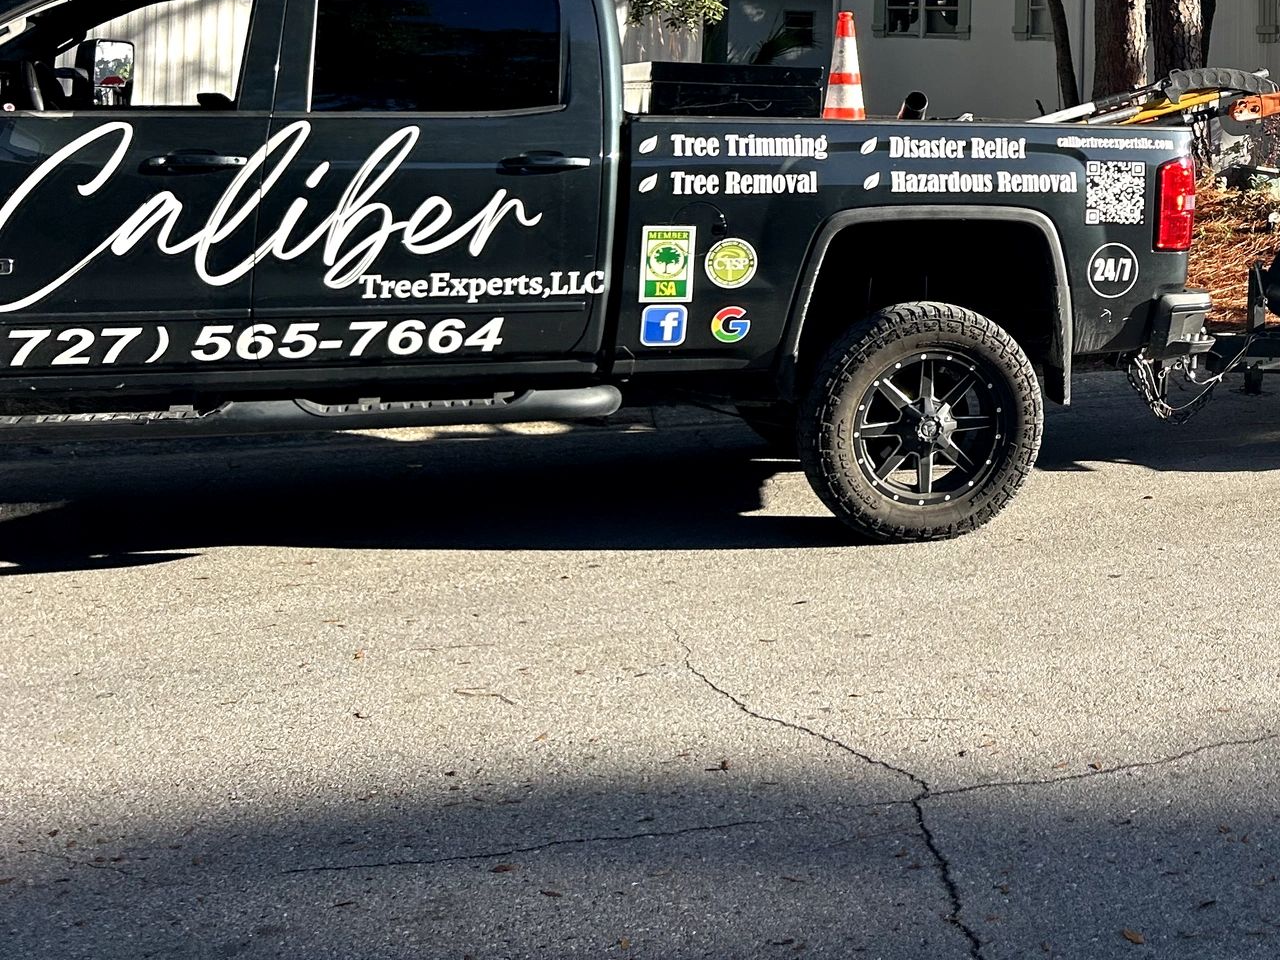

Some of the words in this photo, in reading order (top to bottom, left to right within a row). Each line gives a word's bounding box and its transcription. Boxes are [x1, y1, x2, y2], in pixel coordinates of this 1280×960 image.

[671, 133, 720, 157] Tree
[725, 133, 829, 160] Trimming
[889, 136, 967, 159] Disaster
[970, 137, 1027, 159] Relief
[671, 171, 720, 195] Tree
[725, 171, 818, 195] Removal
[891, 170, 993, 193] Hazardous
[997, 171, 1078, 193] Removal
[0, 120, 543, 313] Caliber
[648, 231, 689, 239] MEMBER
[1094, 257, 1133, 284] 24/7
[359, 270, 605, 303] TreeExperts,LLC
[654, 281, 677, 296] ISA
[191, 317, 505, 363] 565-7664
